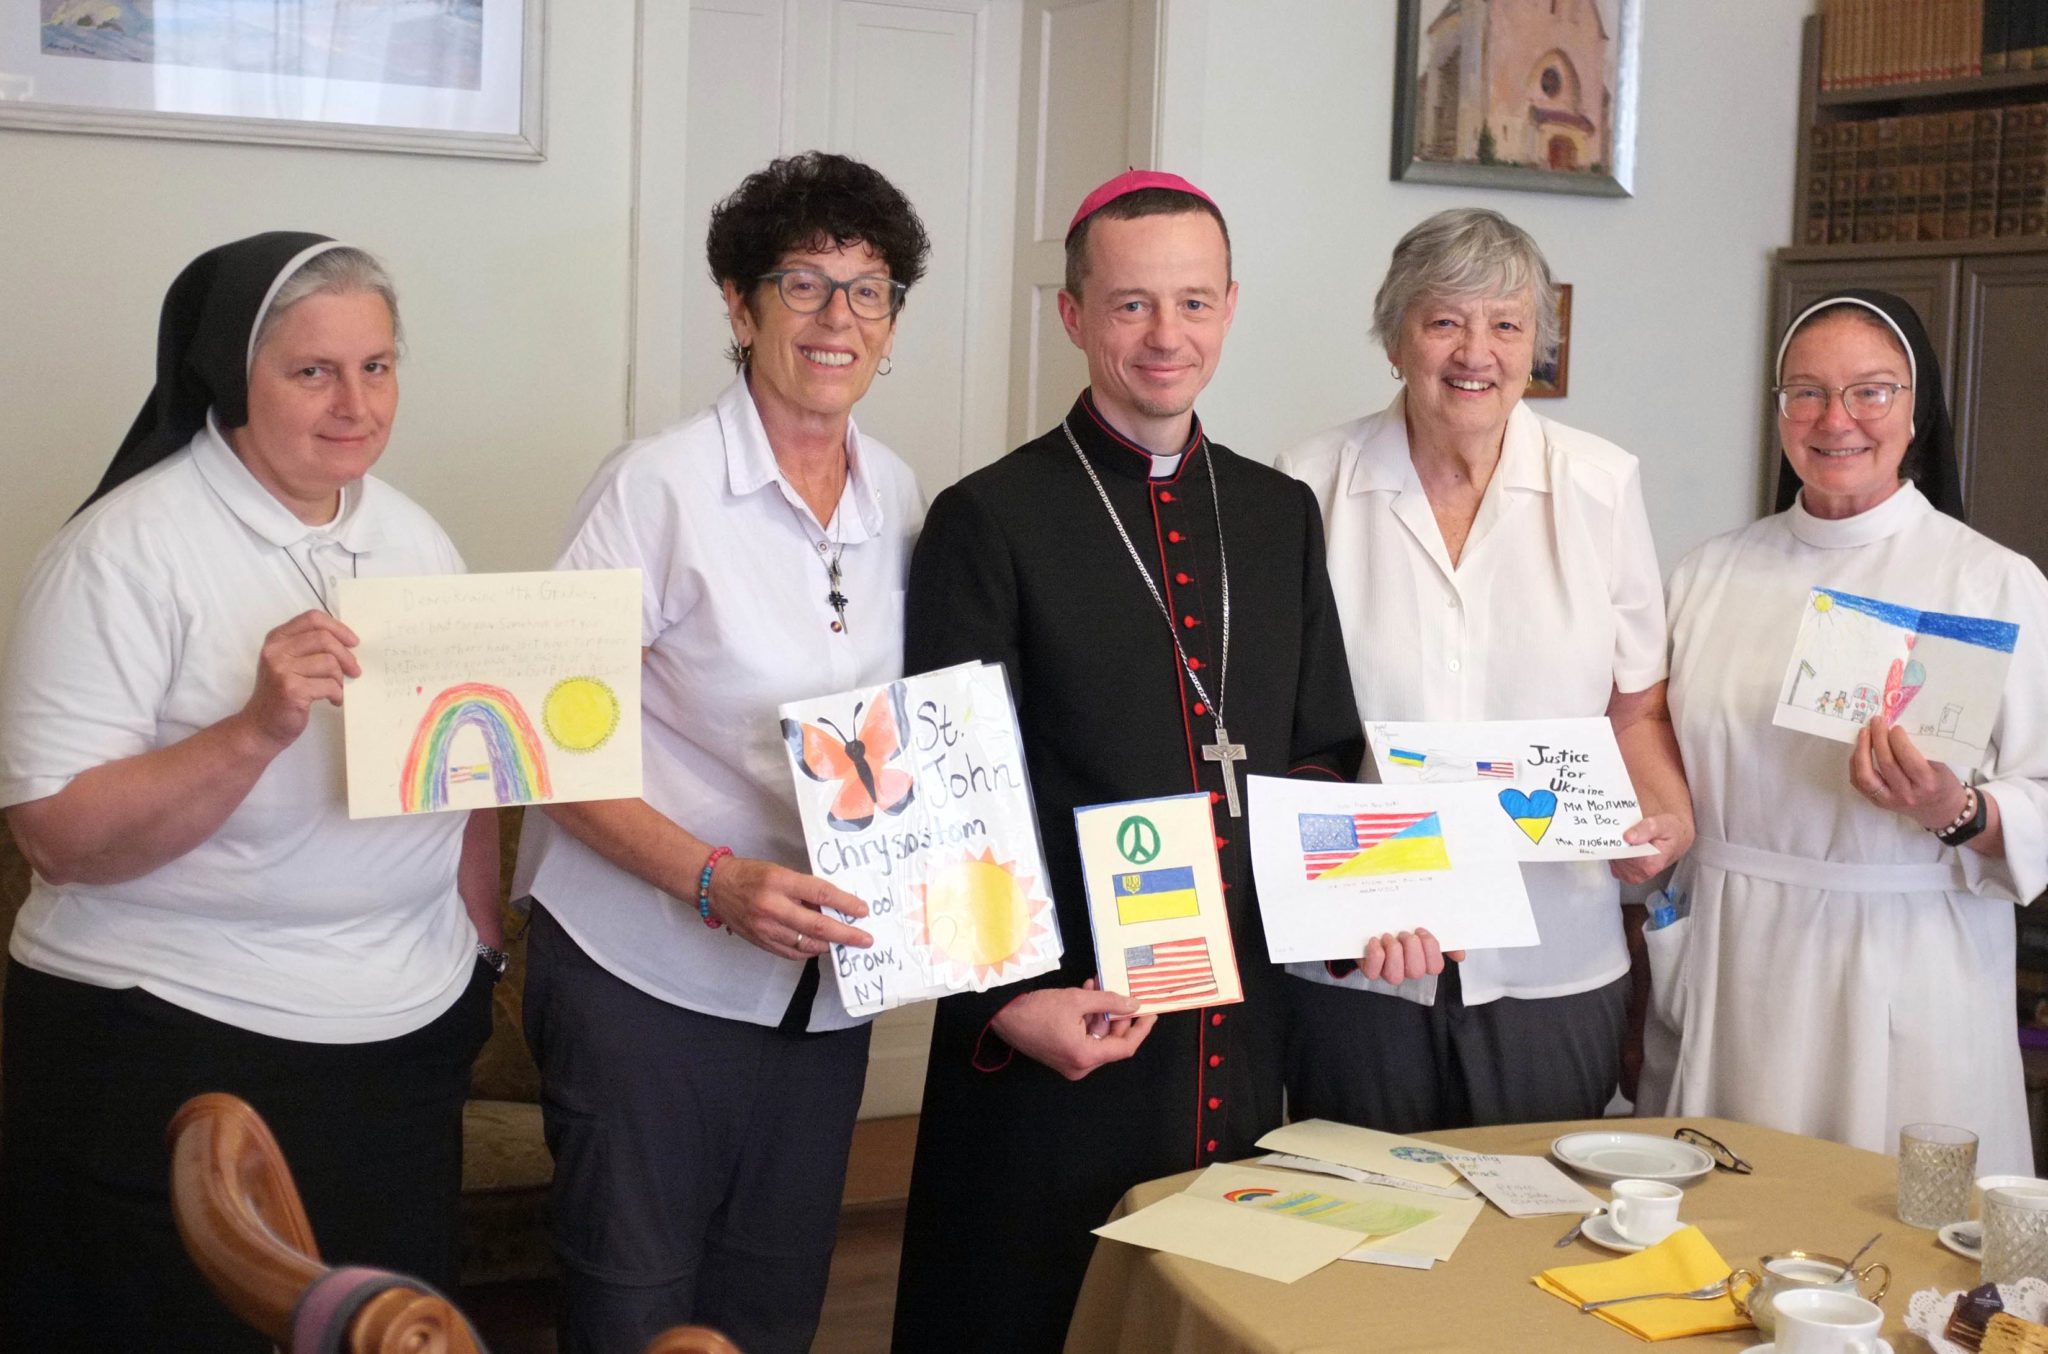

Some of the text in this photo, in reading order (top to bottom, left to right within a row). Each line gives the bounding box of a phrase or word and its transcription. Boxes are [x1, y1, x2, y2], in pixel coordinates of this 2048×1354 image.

[916, 700, 964, 751] St.
[1527, 744, 1590, 766] Justice
[922, 752, 1021, 809] John
[1556, 765, 1587, 778] for
[1549, 777, 1605, 796] Ukraine
[854, 975, 884, 1006] NY
